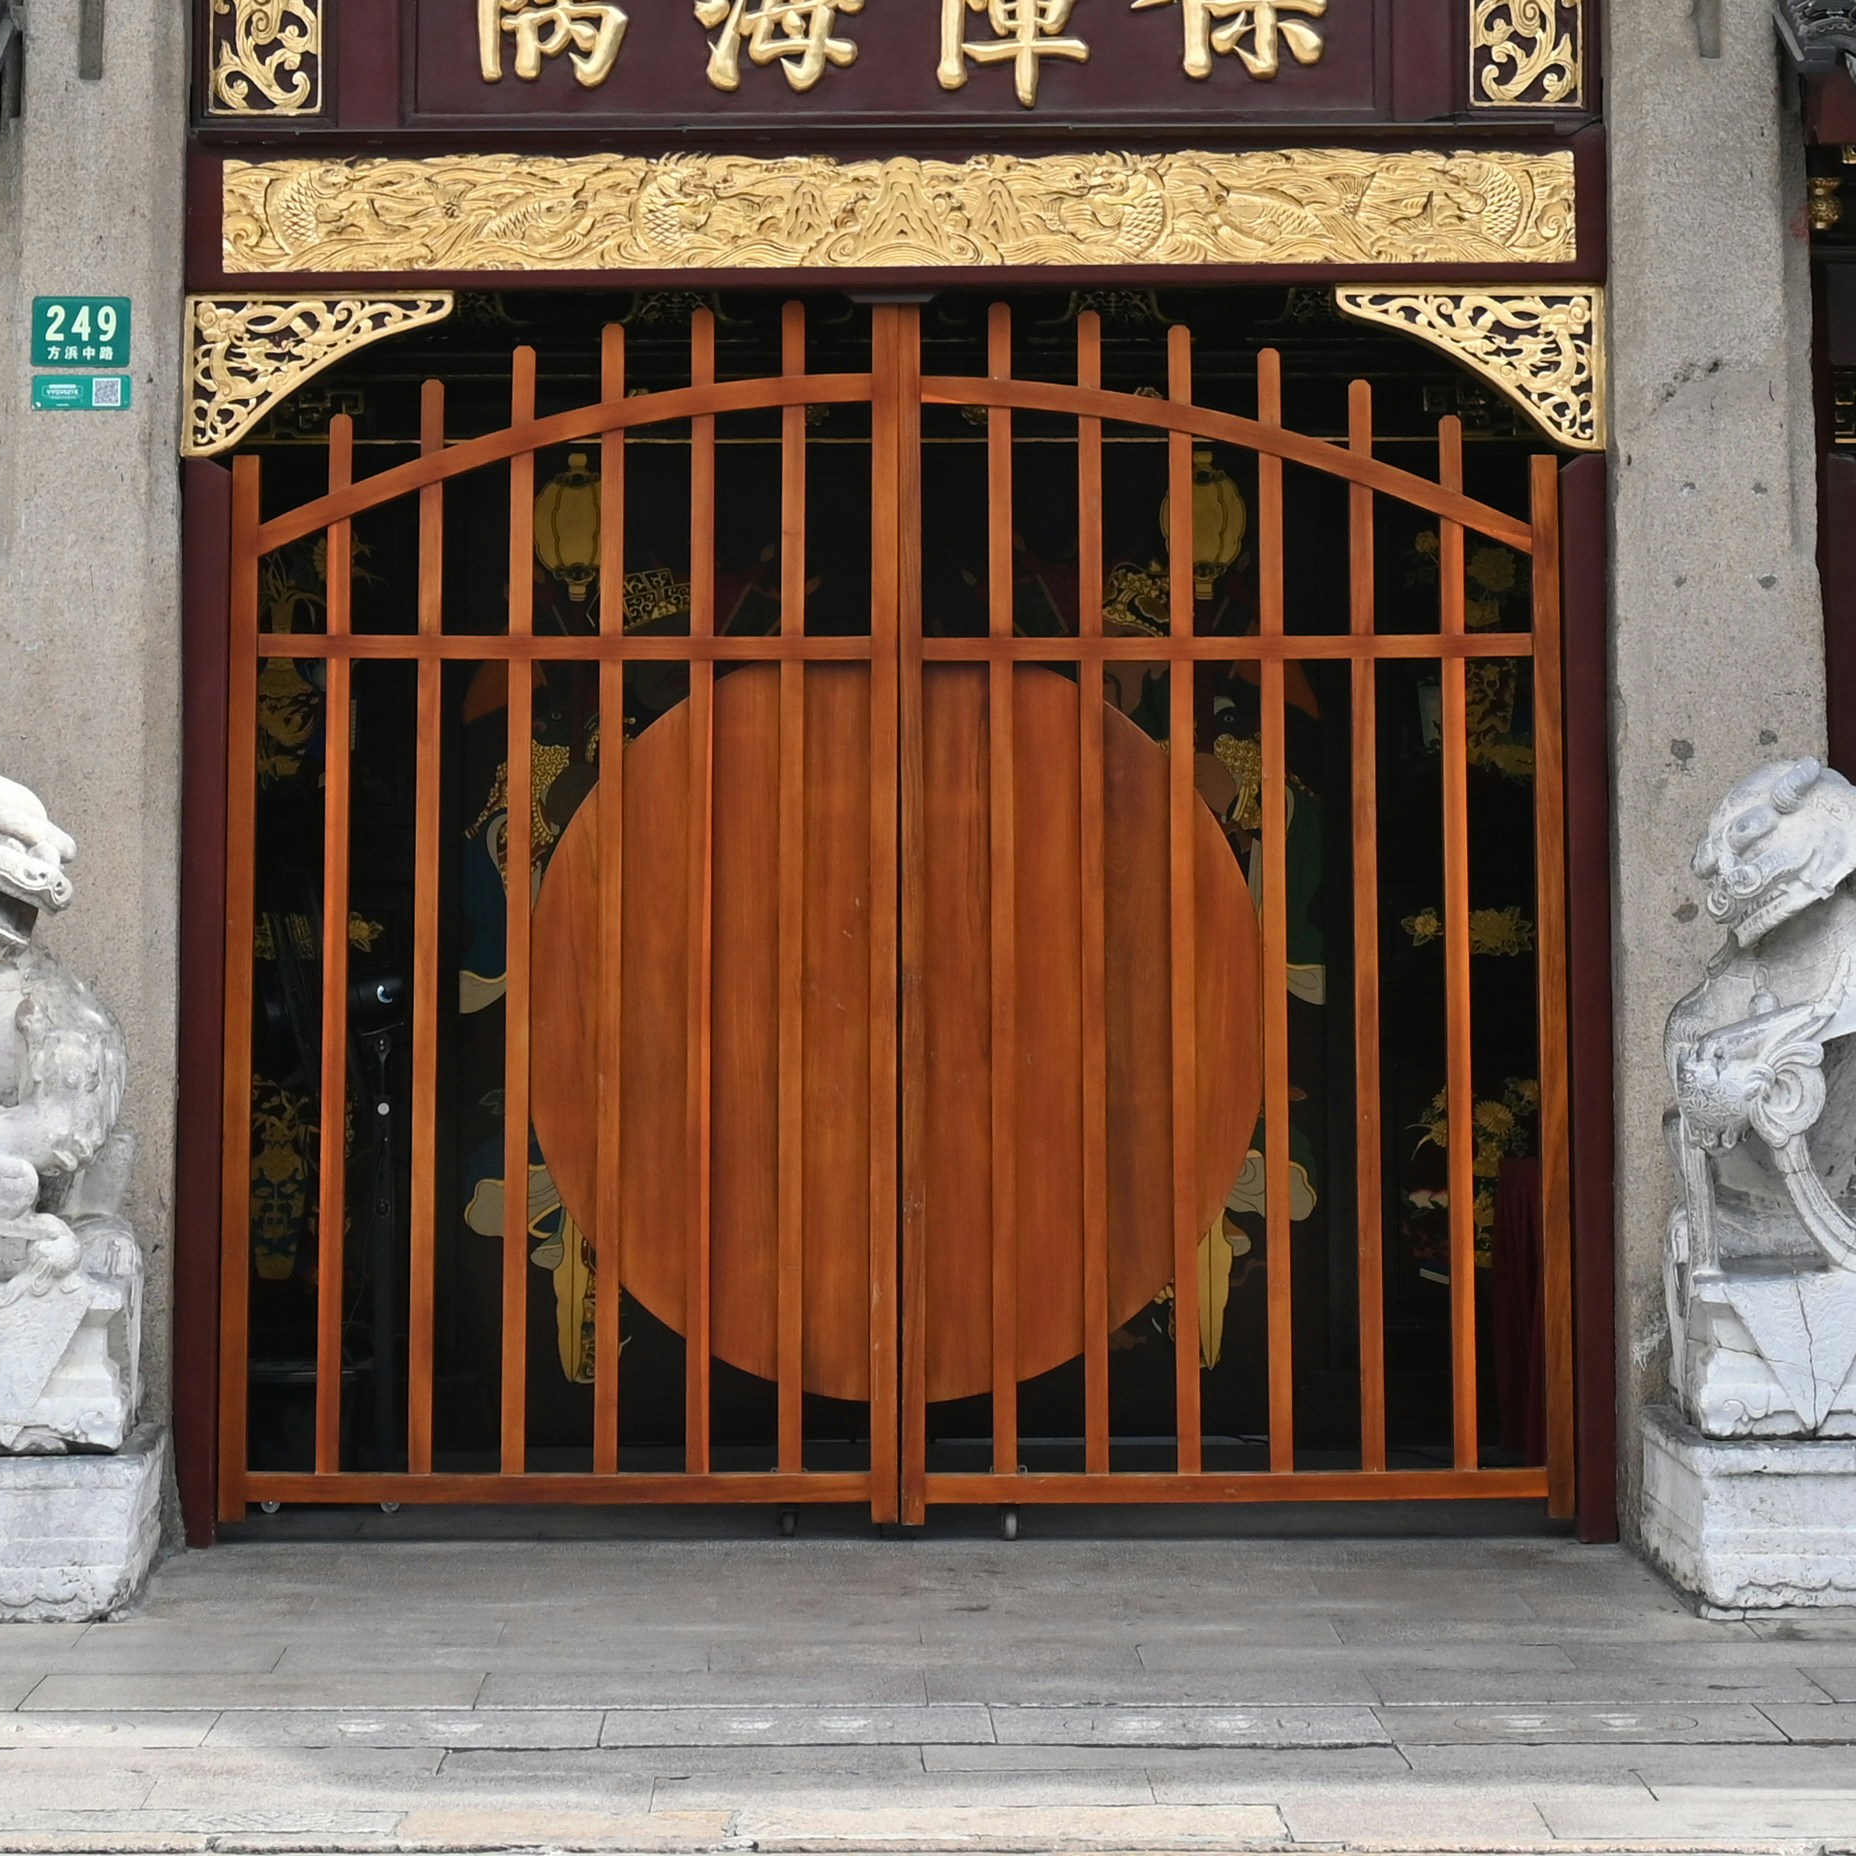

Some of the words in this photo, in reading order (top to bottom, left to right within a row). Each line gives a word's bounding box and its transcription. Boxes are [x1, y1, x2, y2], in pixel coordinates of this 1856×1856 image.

[45, 304, 117, 342] 249
[47, 345, 114, 361] 方浜中路
